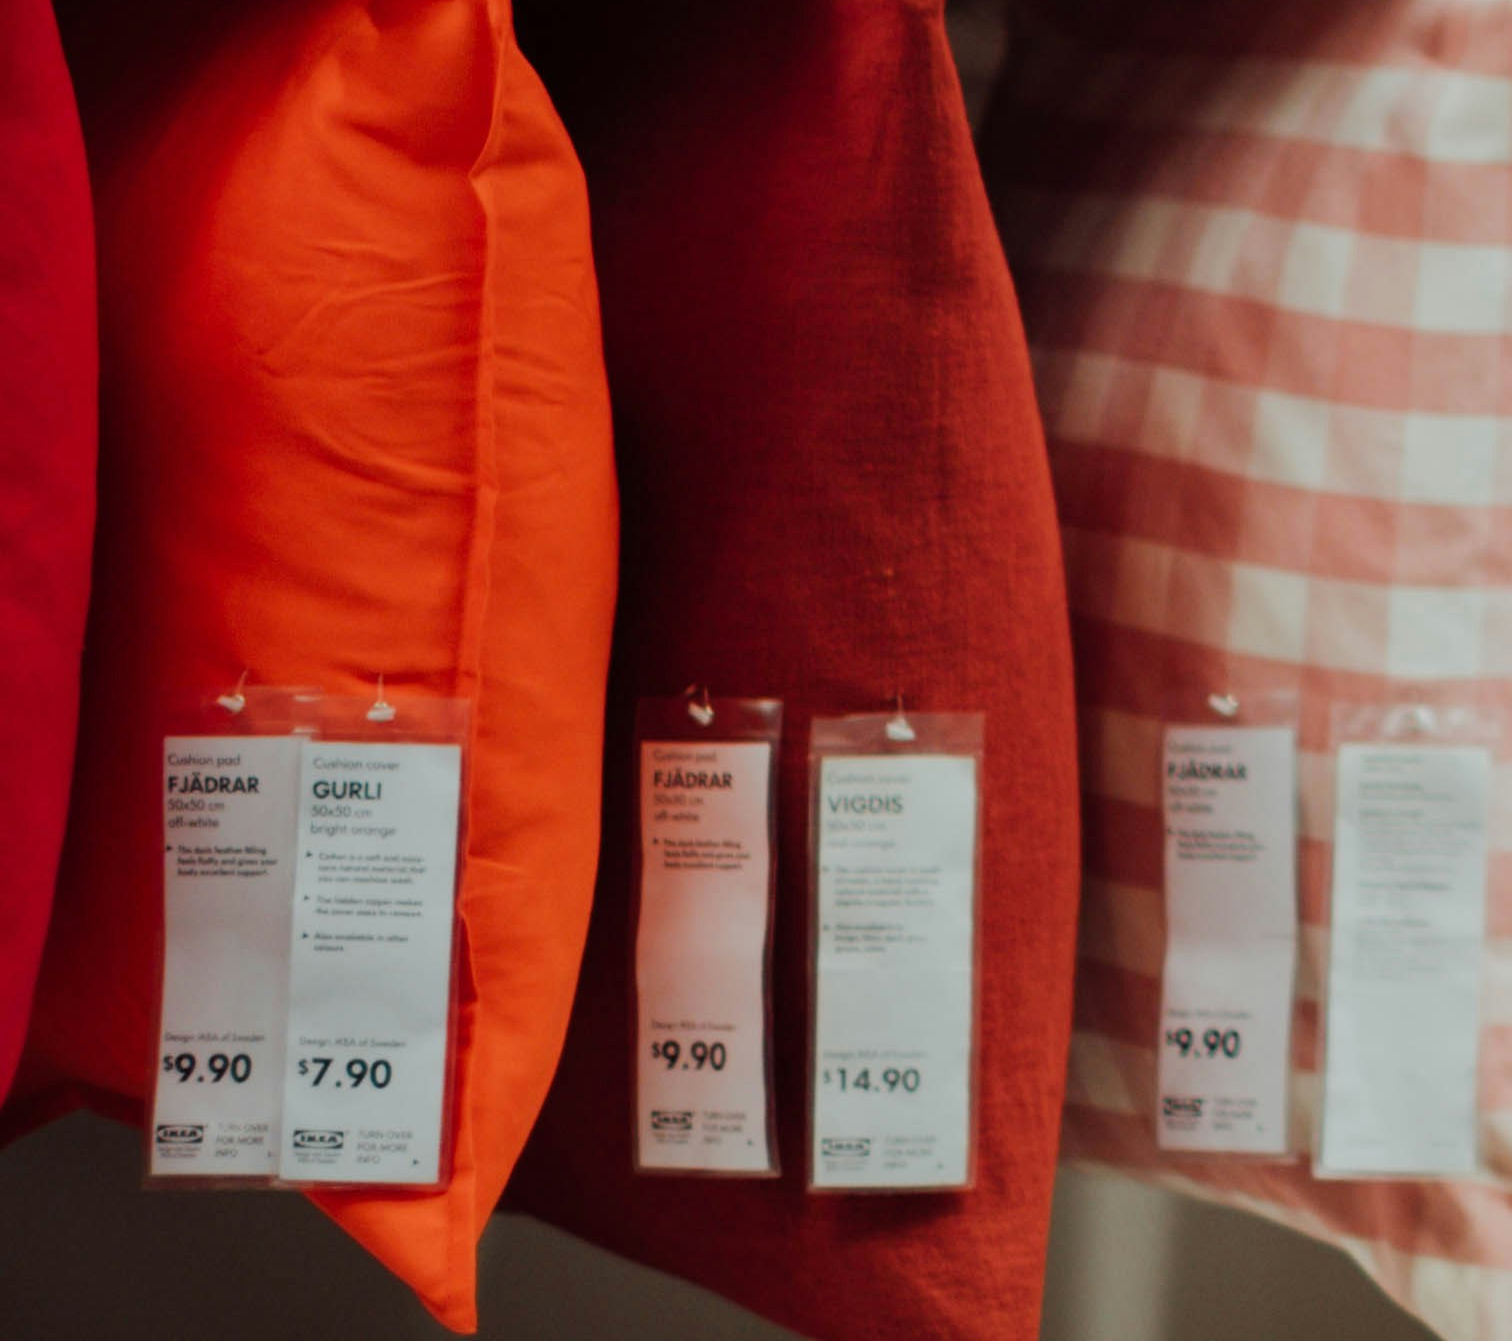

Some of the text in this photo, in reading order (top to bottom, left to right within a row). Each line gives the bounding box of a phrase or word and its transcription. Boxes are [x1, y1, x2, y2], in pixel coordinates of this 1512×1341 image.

[168, 772, 259, 793] FJÄDRAR
[312, 781, 382, 800] GURLI
[827, 795, 904, 813] VIGDIS
[163, 1053, 252, 1083] $9.90
[652, 1040, 726, 1071] $9.90
[299, 1058, 392, 1089] $7.90
[824, 1067, 920, 1092] $14.90
